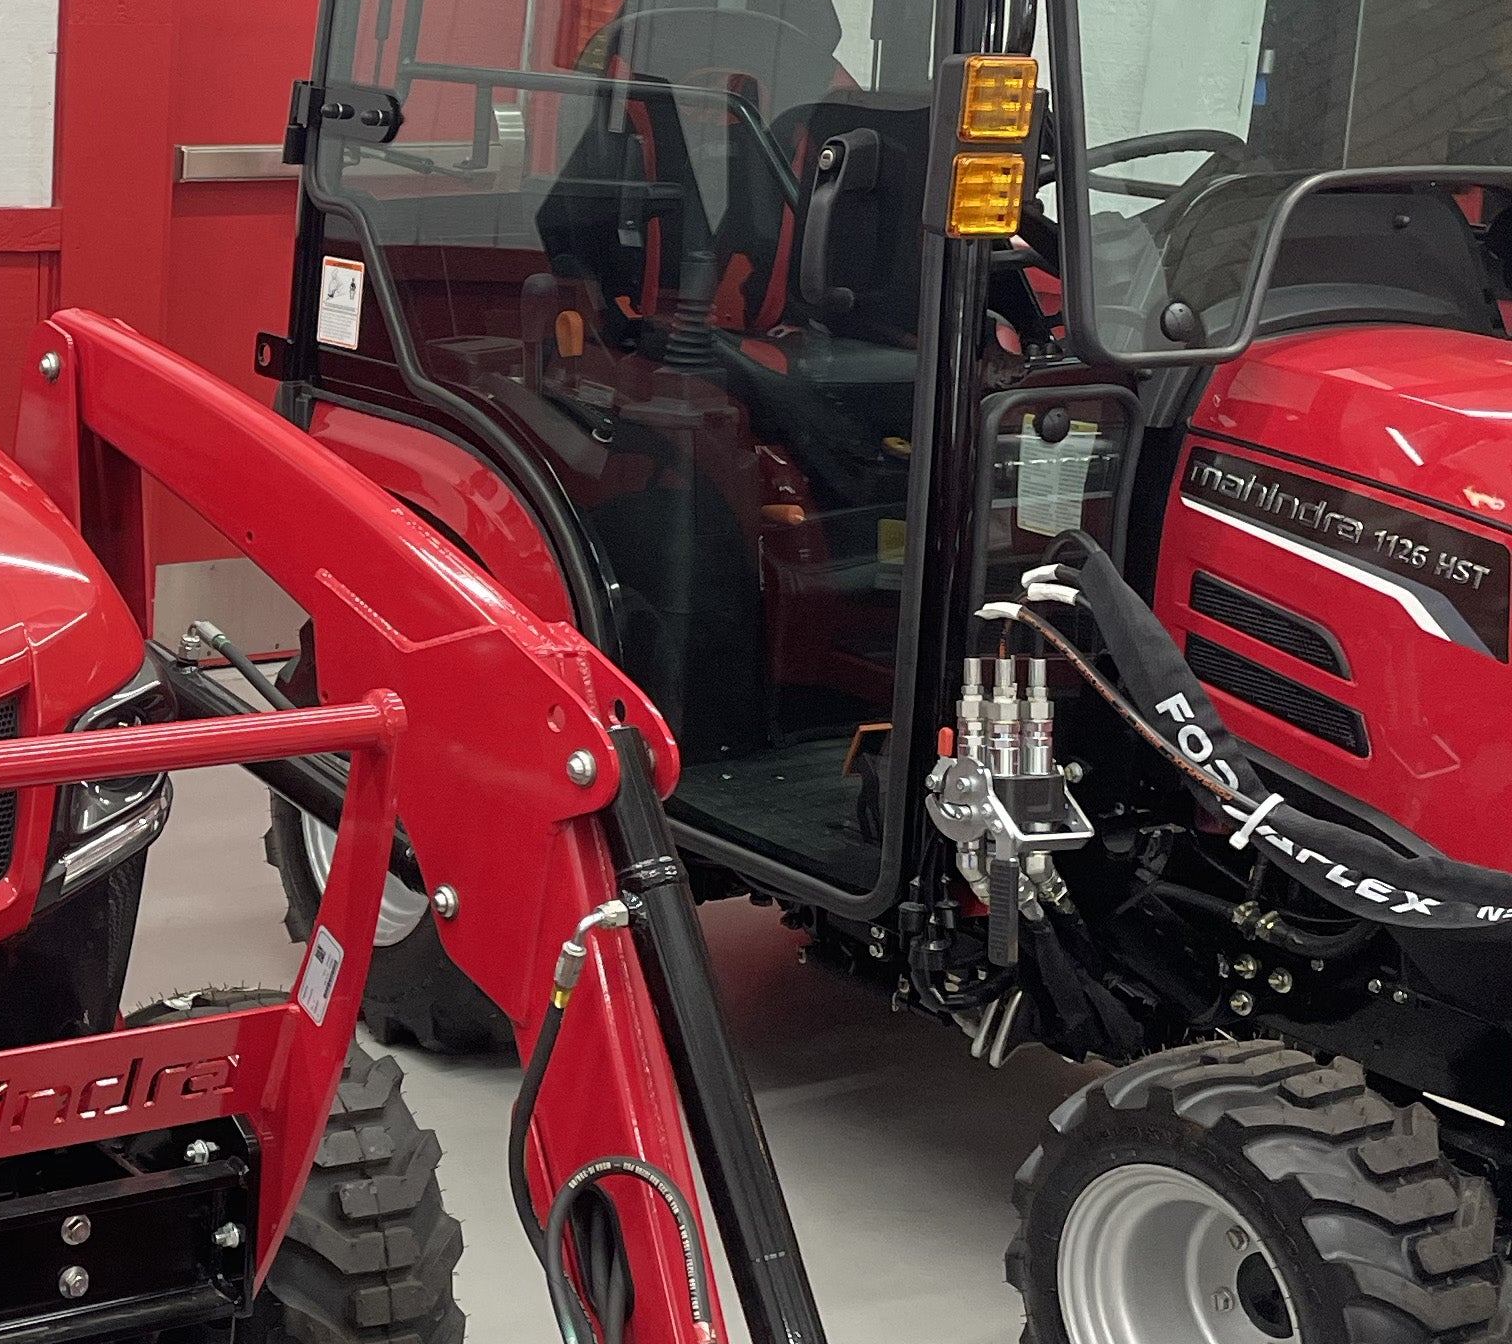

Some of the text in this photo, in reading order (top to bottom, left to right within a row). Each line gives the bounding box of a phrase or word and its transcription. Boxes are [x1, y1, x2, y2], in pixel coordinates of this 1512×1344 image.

[1190, 458, 1491, 590] mahindra 1126 HST
